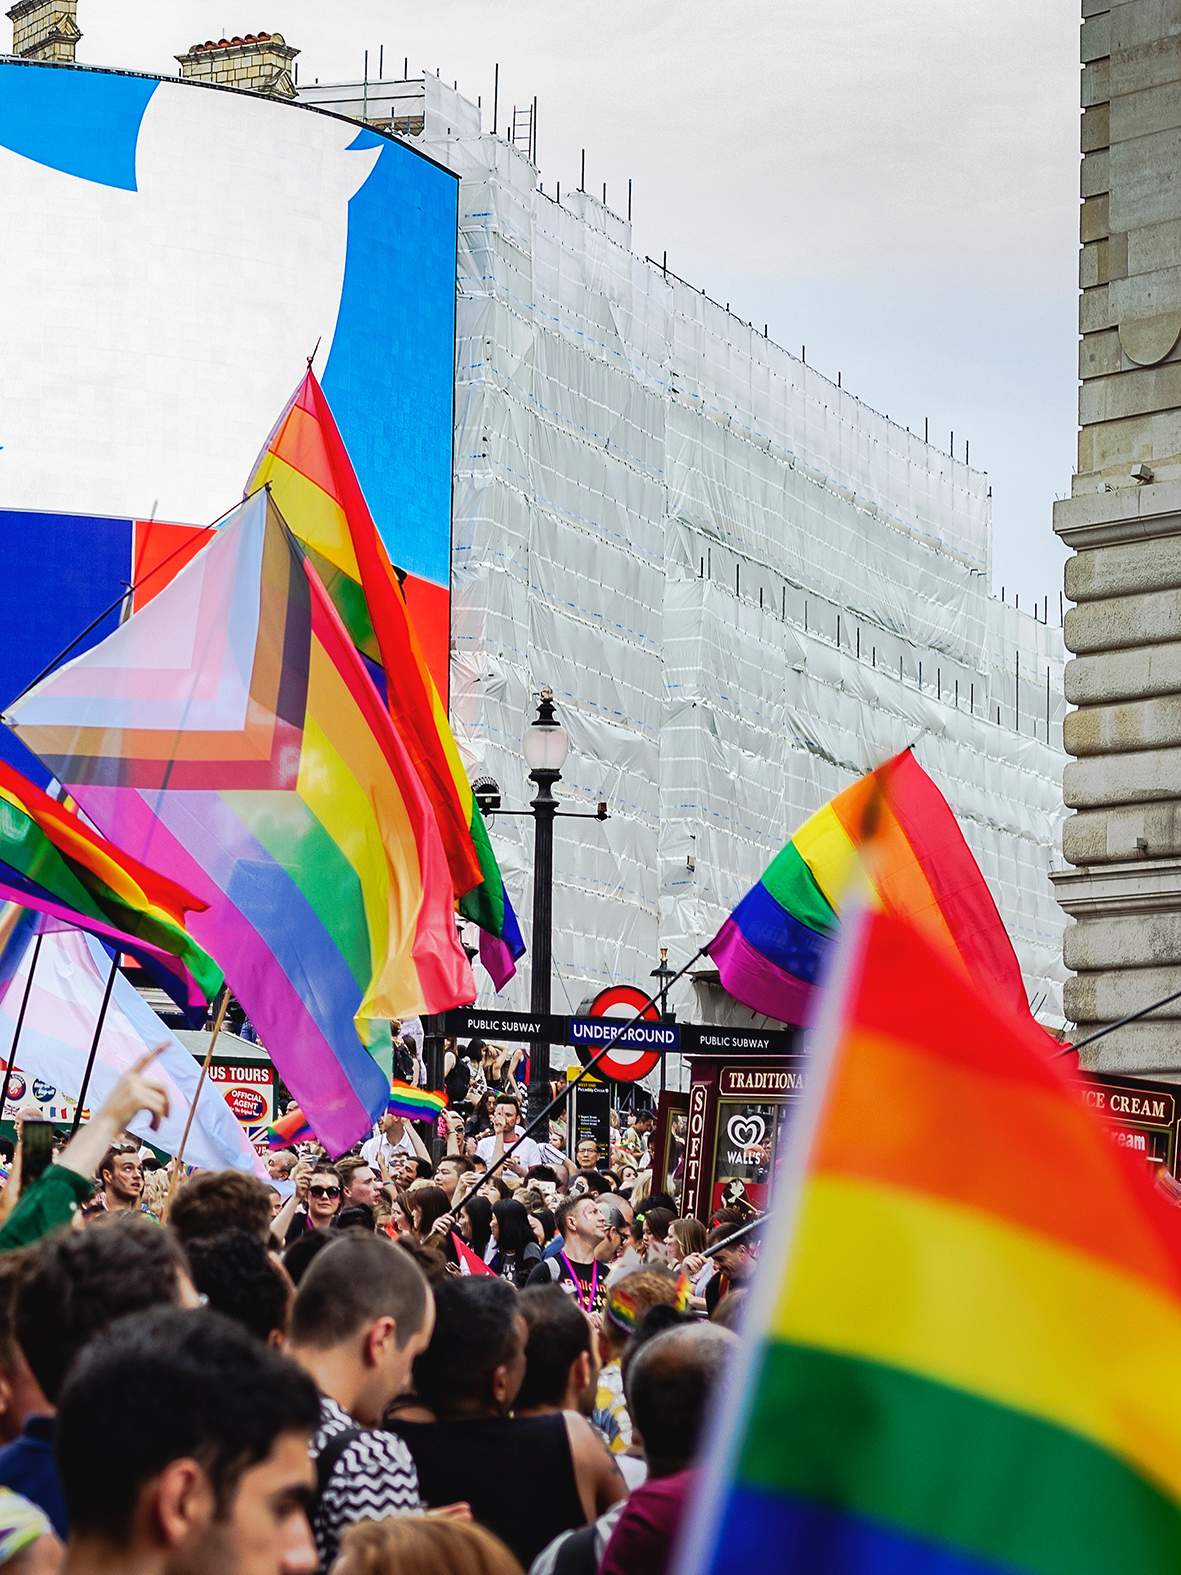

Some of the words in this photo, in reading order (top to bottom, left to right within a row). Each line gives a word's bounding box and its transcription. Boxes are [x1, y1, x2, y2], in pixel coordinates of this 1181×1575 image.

[467, 1018, 499, 1032] PUBLIC
[501, 1020, 541, 1034] SUBWAY
[573, 1023, 675, 1045] UNDERGROUND
[699, 1034, 729, 1048] PUBLIC
[731, 1036, 770, 1050] SUBWAY
[208, 1065, 227, 1080] US
[229, 1067, 270, 1083] TOURS
[729, 1072, 805, 1090] TRADITIONA
[231, 1089, 263, 1103] OFFICIAL
[233, 1098, 259, 1111] AGENT
[1081, 1090, 1105, 1109] ICE
[1110, 1095, 1166, 1118] CREAM
[688, 1091, 704, 1180] SOFT
[1109, 1130, 1146, 1151] ream
[727, 1150, 762, 1165] WALL'S
